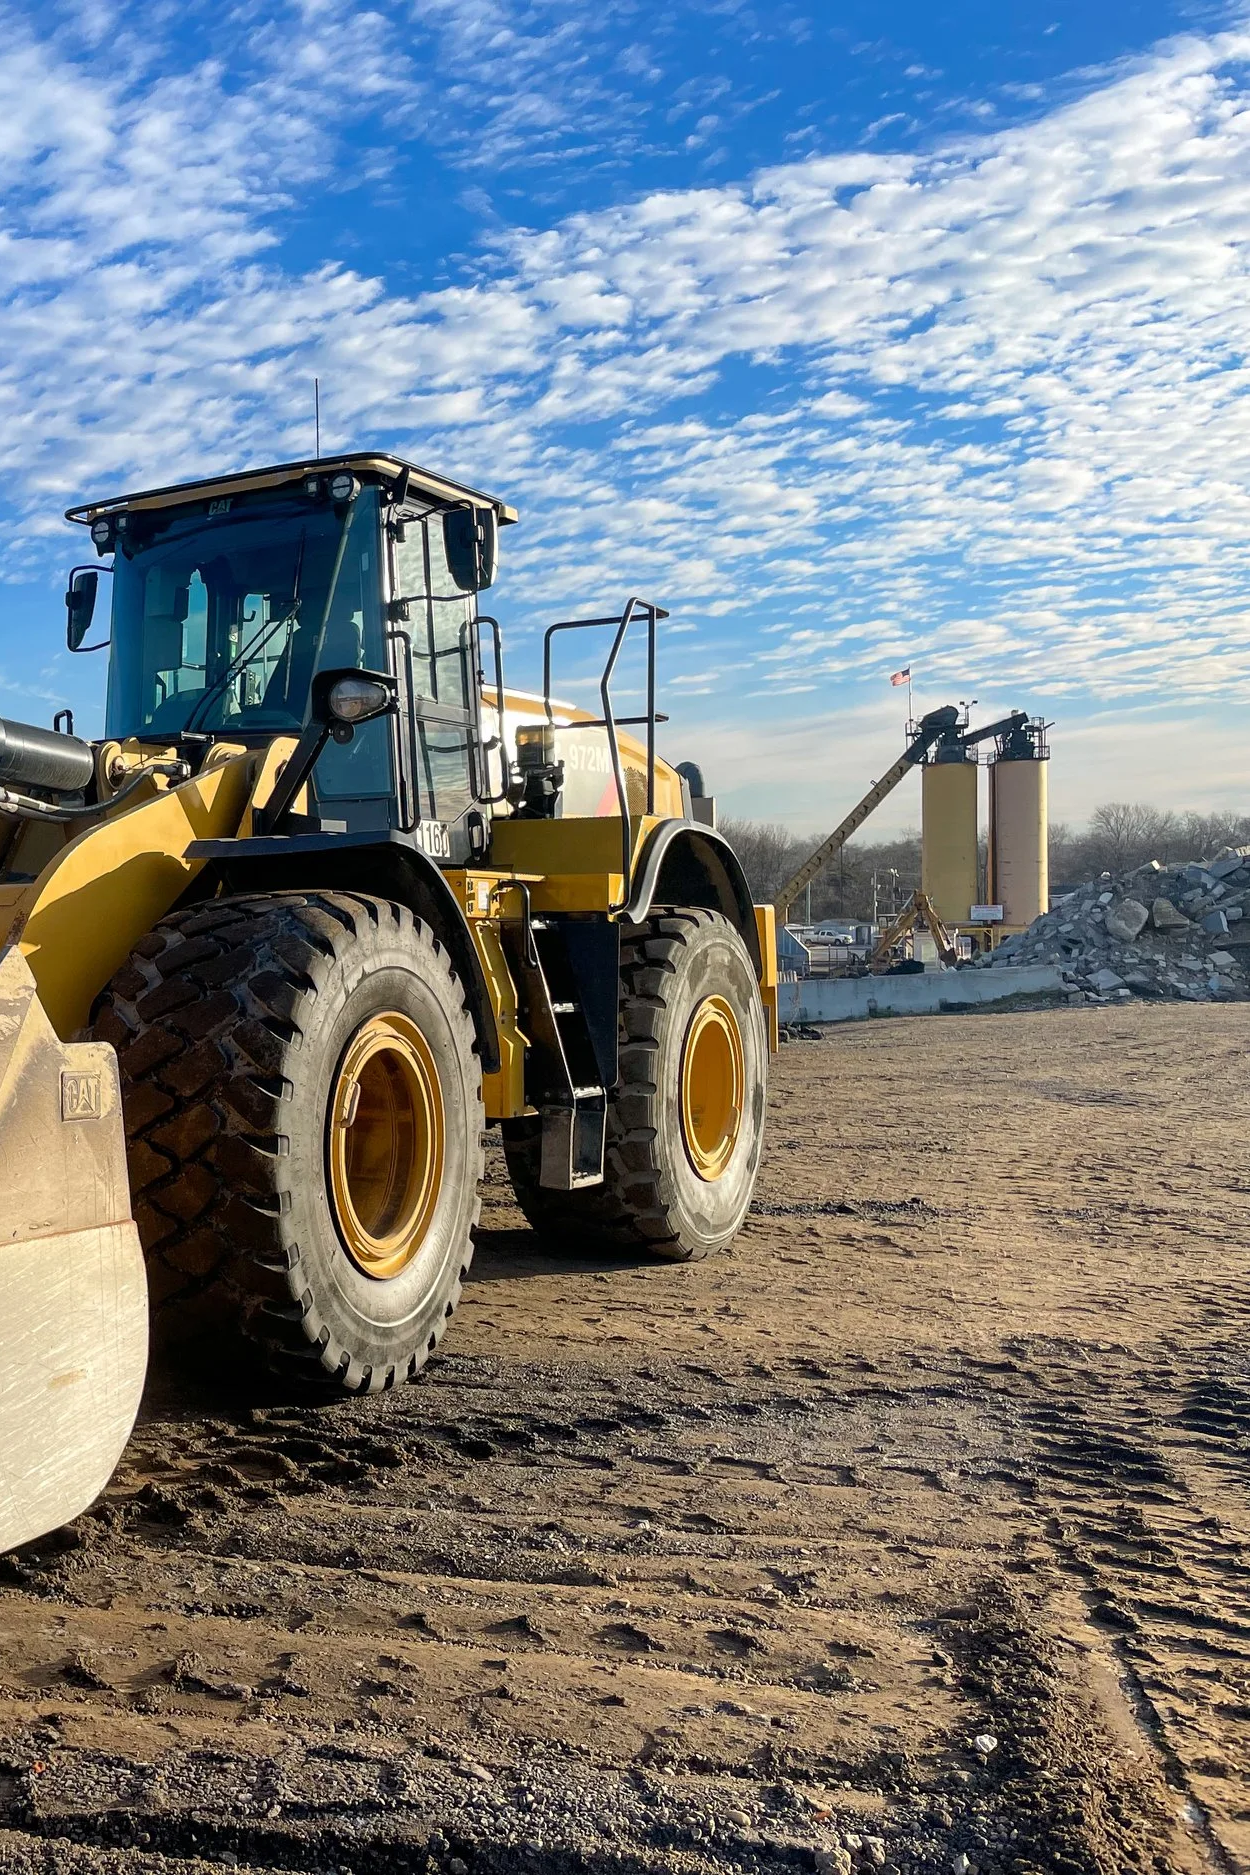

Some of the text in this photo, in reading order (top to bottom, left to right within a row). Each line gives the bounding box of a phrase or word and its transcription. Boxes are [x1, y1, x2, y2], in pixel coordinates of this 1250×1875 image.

[208, 498, 234, 515] CAT
[569, 743, 610, 774] 972M
[66, 1078, 97, 1114] CAT
